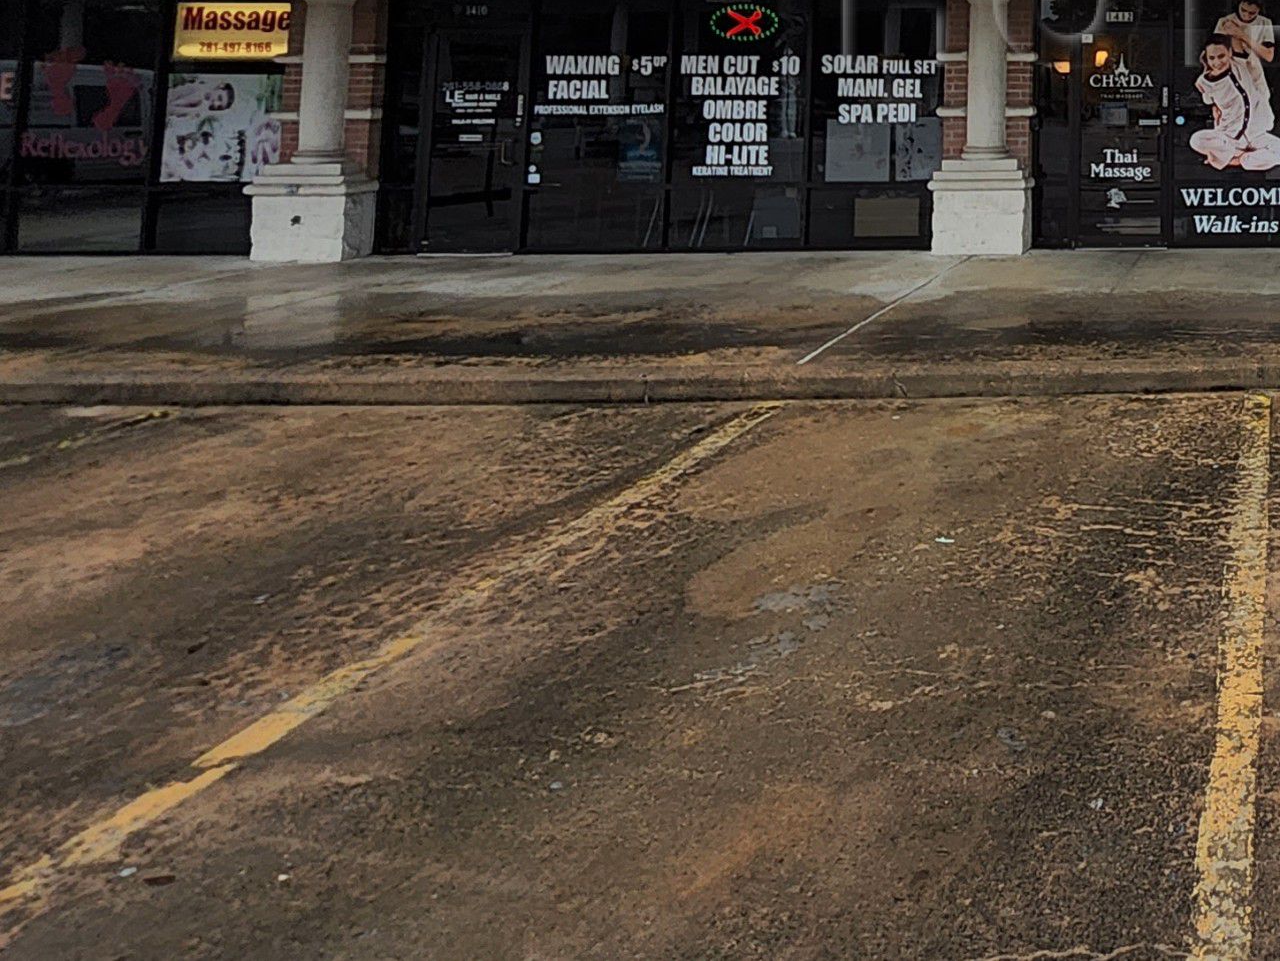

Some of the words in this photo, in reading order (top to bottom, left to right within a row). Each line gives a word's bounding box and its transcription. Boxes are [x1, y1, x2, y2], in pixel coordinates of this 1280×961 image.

[183, 6, 291, 33] Massage
[546, 56, 620, 75] WAXING
[680, 56, 719, 75] MEN
[723, 56, 760, 75] CUT
[772, 56, 800, 75] $10
[821, 55, 878, 74] SOLAR
[882, 60, 911, 74] FULL
[914, 60, 938, 74] SET
[548, 80, 609, 99] FACIAL
[691, 77, 779, 96] BALAYAGE
[837, 78, 888, 98] MANI.
[892, 78, 922, 98] GEL
[1089, 74, 1153, 87] CHADA
[534, 105, 588, 115] PROFESSIONAL
[589, 104, 630, 115] EXTENSION
[632, 103, 665, 114] EYELASH
[703, 100, 767, 120] OMBRE
[838, 103, 873, 124] SPA
[876, 103, 916, 123] PEDI
[708, 123, 768, 142] COLOR
[705, 145, 769, 165] HI-LITE
[1103, 149, 1138, 164] Thai
[1090, 164, 1151, 180] Massage
[1193, 215, 1279, 233] Walk-ins
